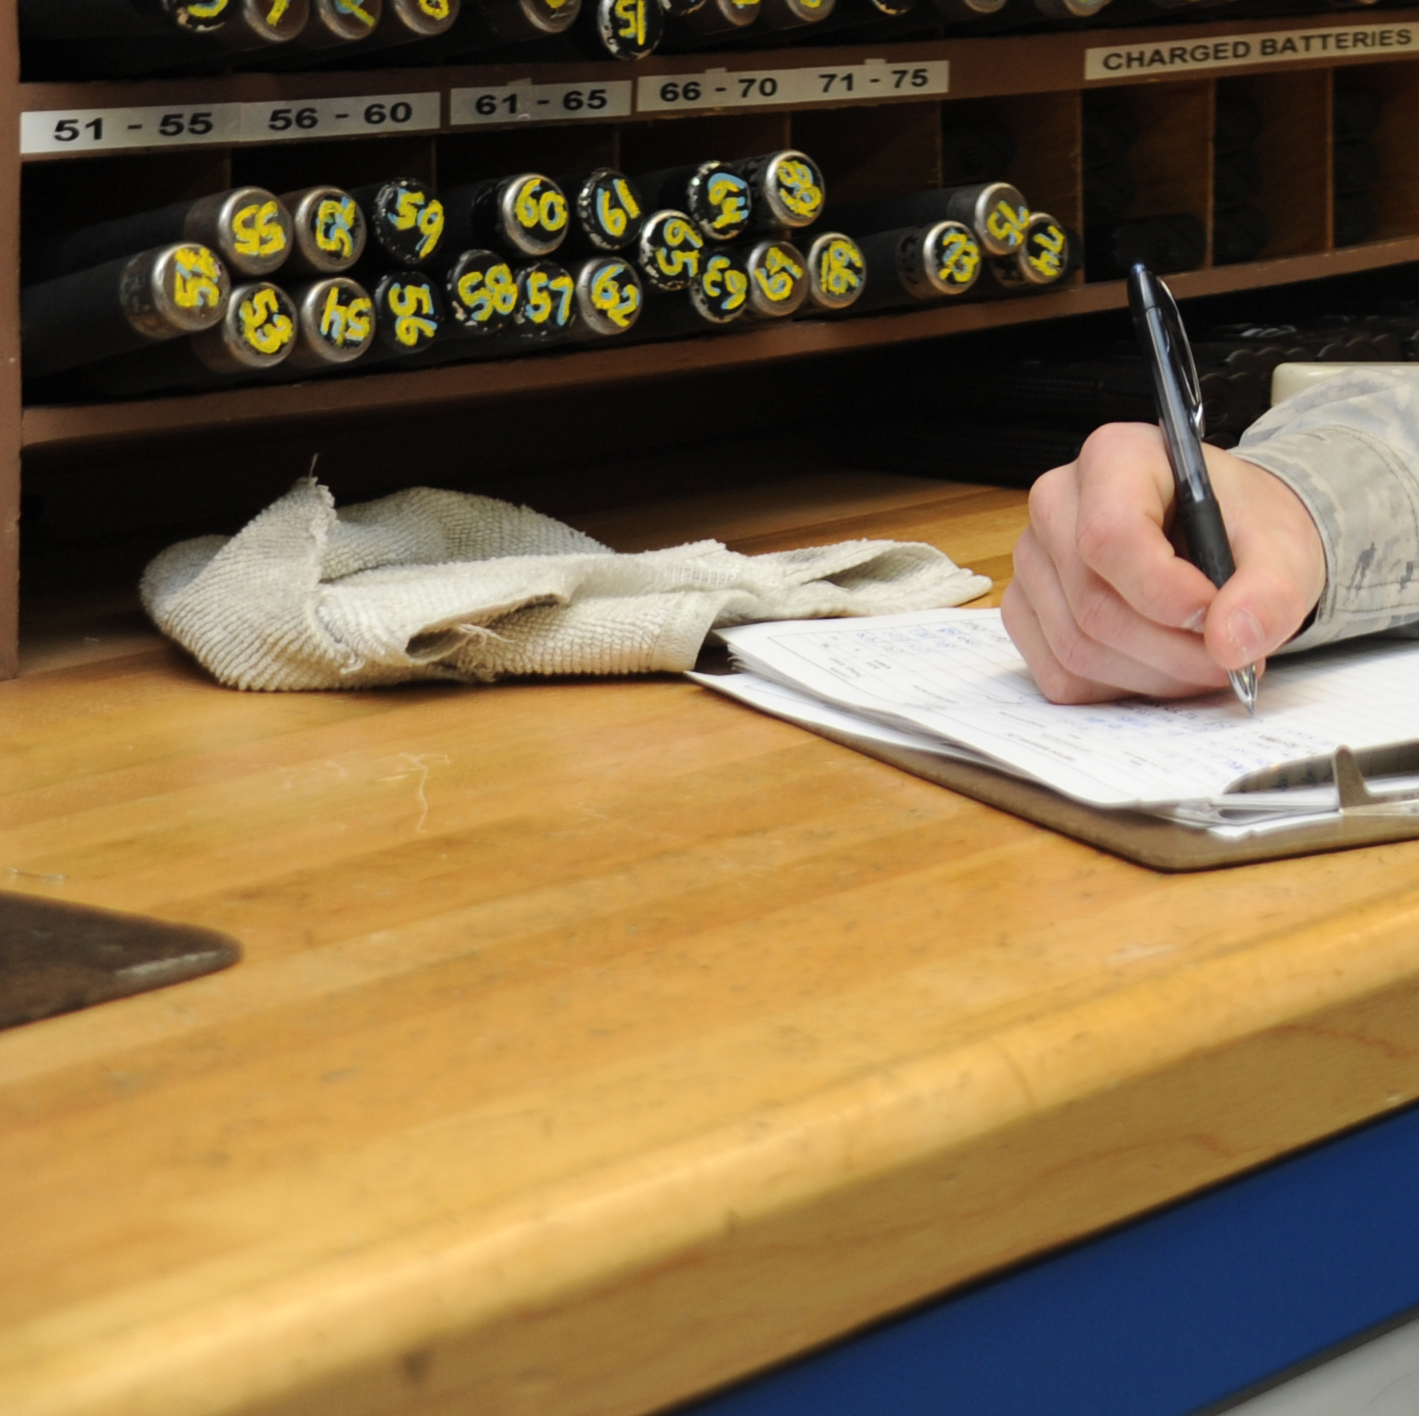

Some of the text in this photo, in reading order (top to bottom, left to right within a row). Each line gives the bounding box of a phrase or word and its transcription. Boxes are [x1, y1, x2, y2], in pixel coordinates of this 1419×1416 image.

[1102, 28, 1413, 71] CHARGED BATTERIES
[475, 93, 518, 116] 61
[563, 89, 608, 111] 65
[660, 81, 702, 102] 66
[738, 77, 778, 98] 70
[819, 73, 854, 93] 71
[891, 68, 929, 89] 75
[53, 117, 104, 142] 51
[159, 112, 214, 136] 55
[268, 108, 319, 131] 56
[363, 101, 413, 125] 60
[233, 200, 286, 257] 55
[387, 188, 445, 259] 59
[515, 179, 568, 231] 60
[388, 282, 437, 347] 56
[458, 262, 519, 322] 58
[525, 271, 574, 326] 57
